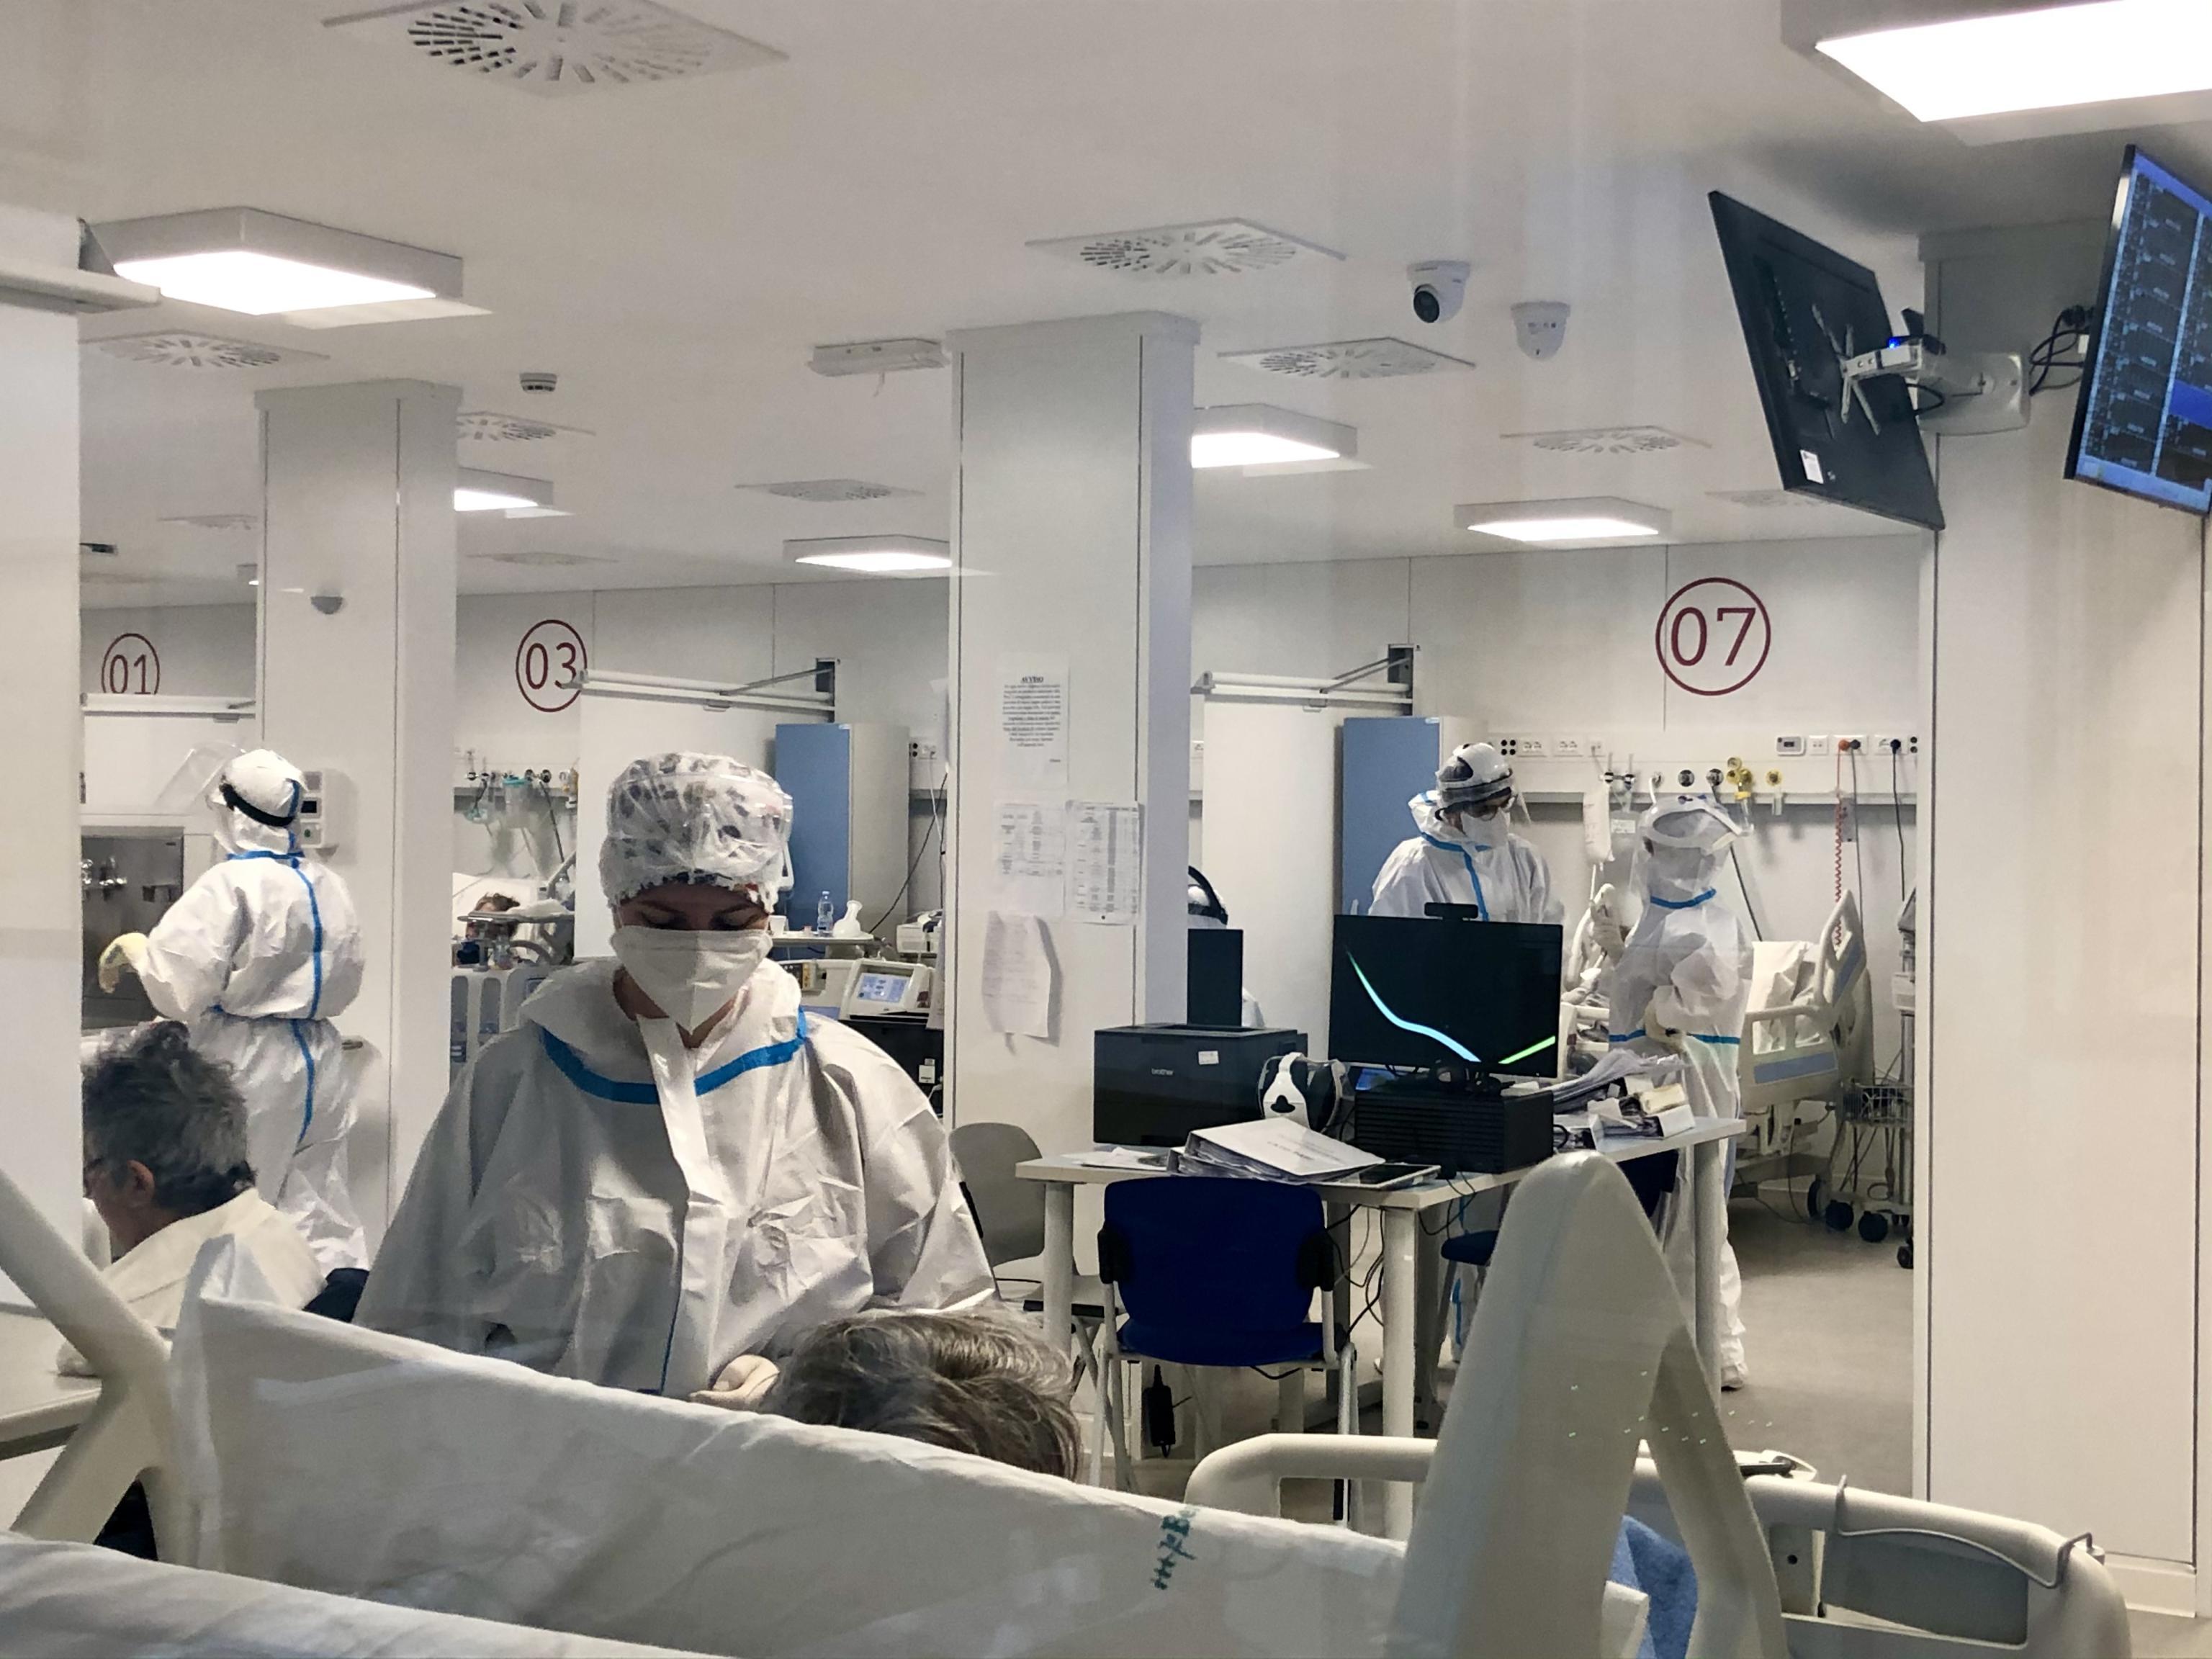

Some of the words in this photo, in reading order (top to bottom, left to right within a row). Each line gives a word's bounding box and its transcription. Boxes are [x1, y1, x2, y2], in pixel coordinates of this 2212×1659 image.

[1671, 606, 1756, 667] 07
[109, 654, 151, 695] 01
[526, 642, 577, 690] 03
